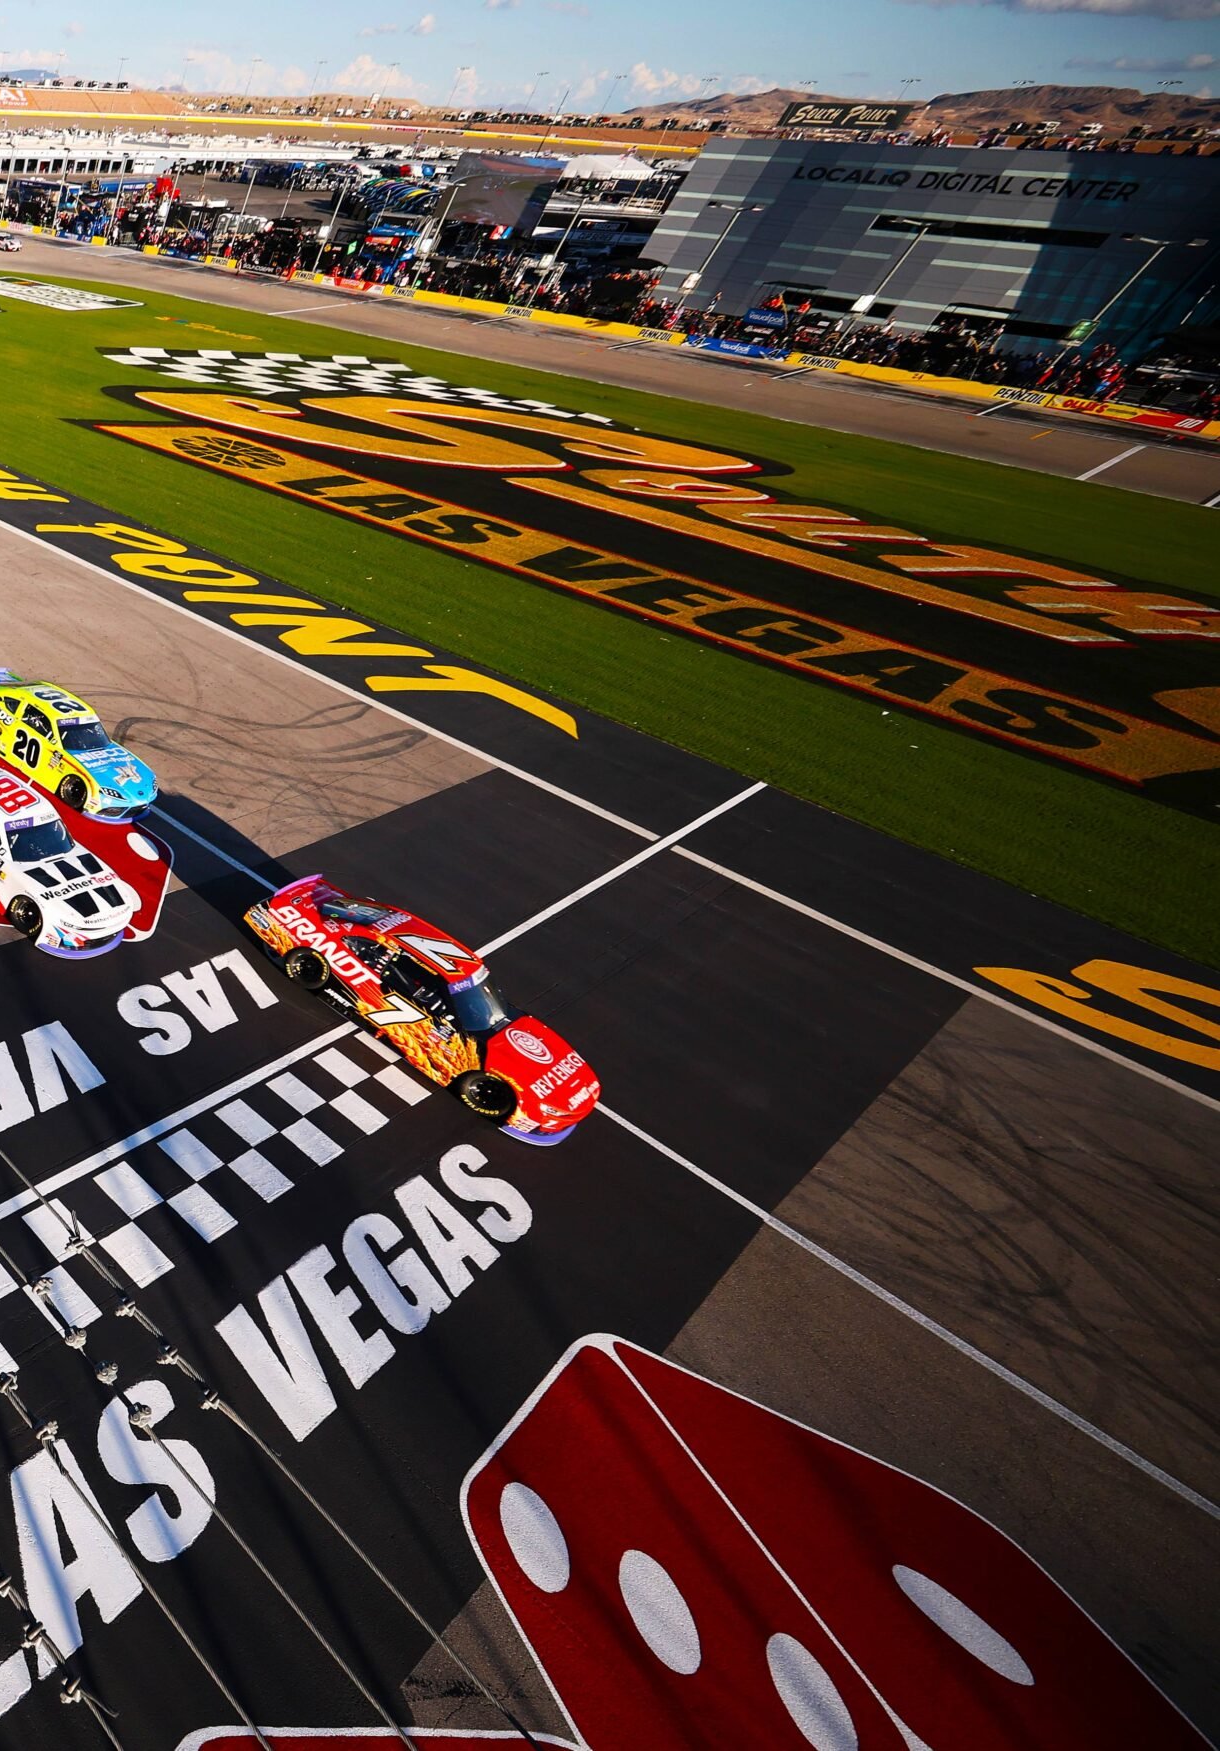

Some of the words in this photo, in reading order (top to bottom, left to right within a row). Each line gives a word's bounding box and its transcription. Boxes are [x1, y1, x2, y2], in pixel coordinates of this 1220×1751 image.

[916, 172, 1012, 195] DIGITAL
[1022, 176, 1140, 201] CENTER
[637, 328, 673, 342] PENNZOIL
[798, 355, 841, 370] PENNZOIL
[994, 387, 1048, 405] PENNZOIL
[278, 474, 523, 544] LAS
[517, 546, 1129, 750] VEGAS
[35, 522, 579, 740] POINT
[11, 729, 41, 769] 20
[73, 747, 129, 763] NIBCO
[40, 871, 121, 901] WeatherTech
[269, 905, 382, 987] BRANDT
[397, 935, 475, 973] 7
[117, 948, 280, 1057] LAS
[365, 993, 427, 1027] 7
[214, 1143, 534, 1444] VEGAS
